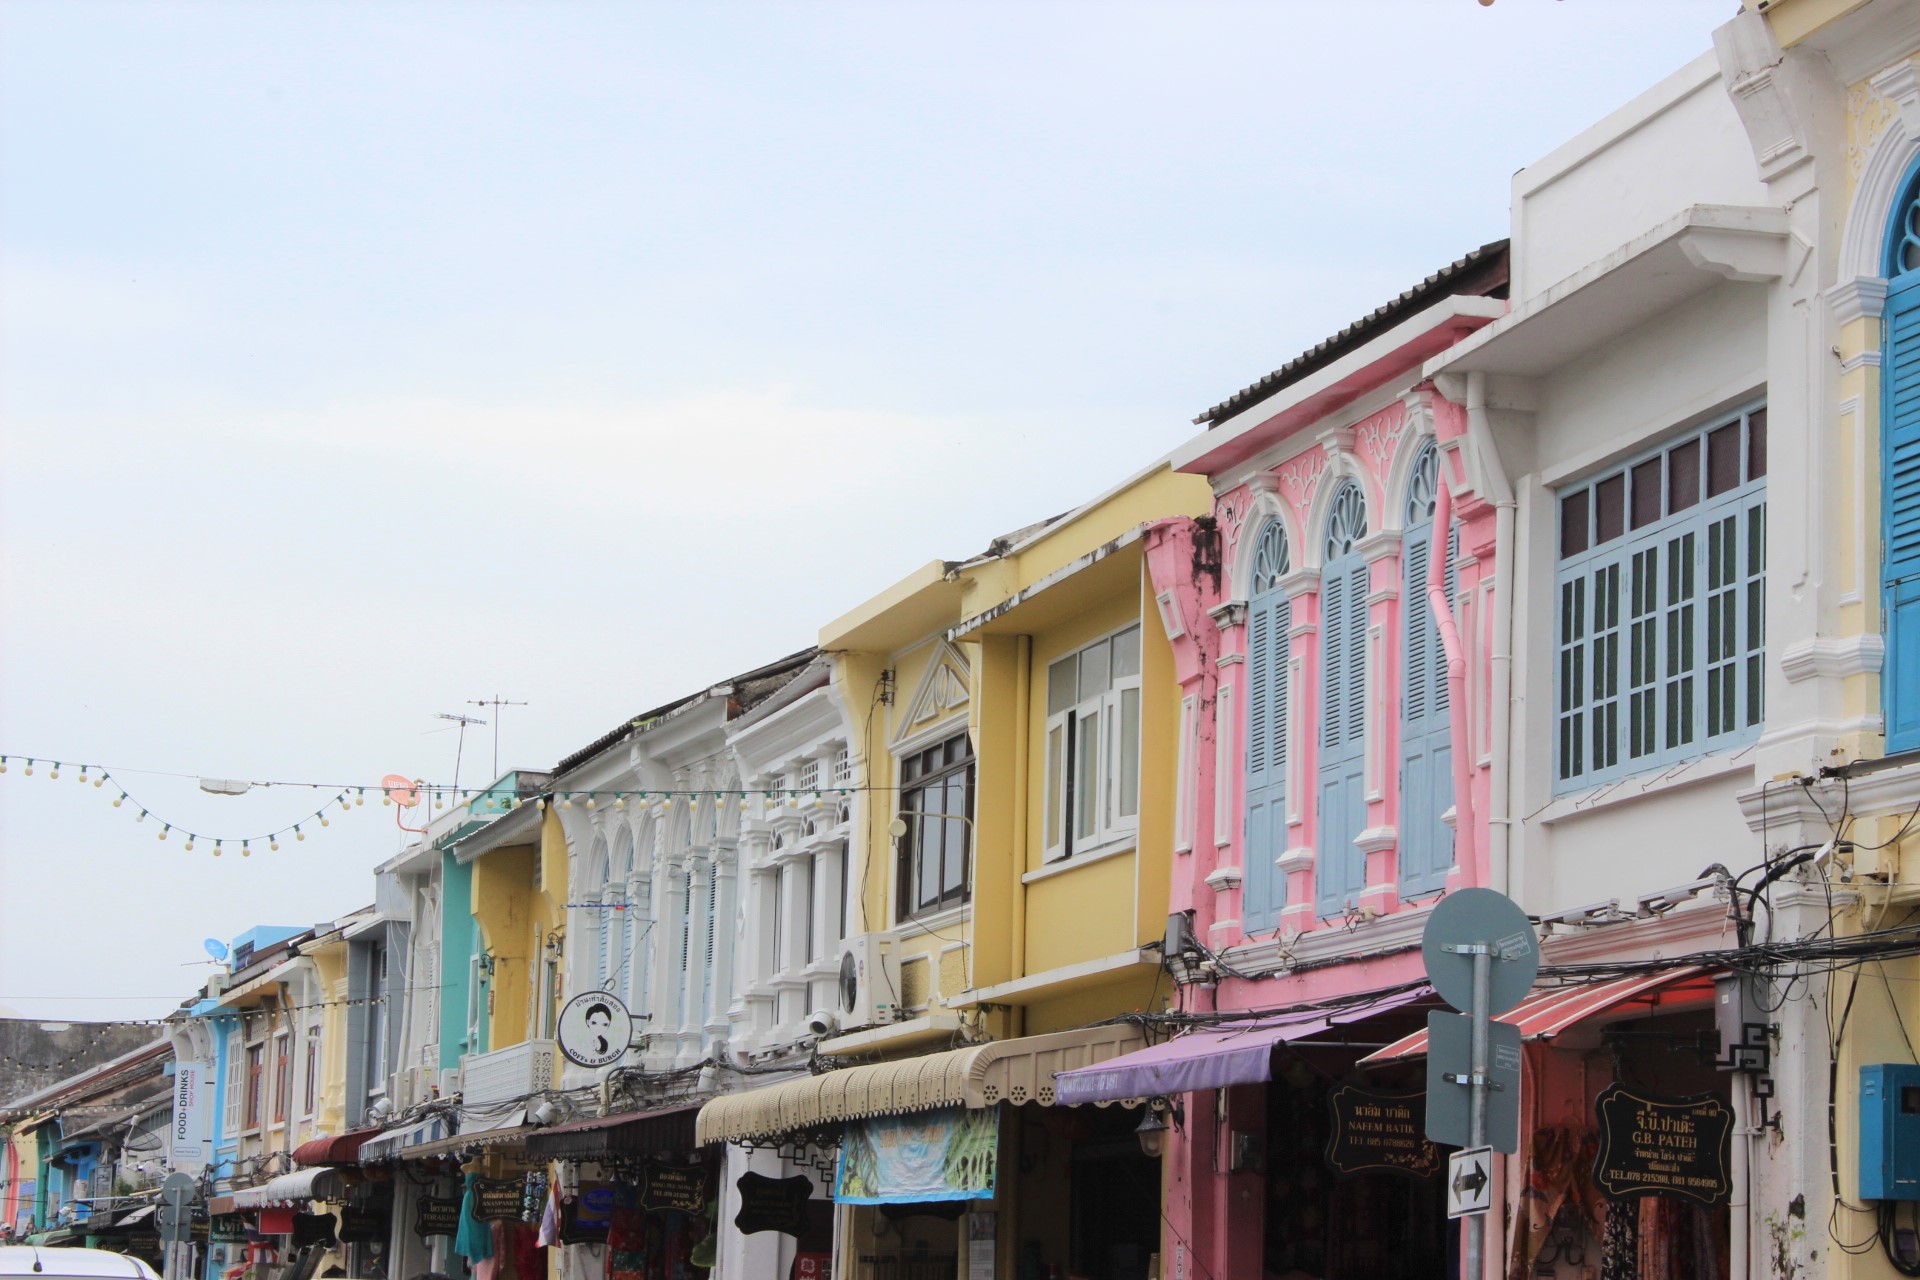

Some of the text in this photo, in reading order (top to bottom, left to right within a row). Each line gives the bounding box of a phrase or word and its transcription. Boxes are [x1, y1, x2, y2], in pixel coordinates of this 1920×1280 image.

[598, 1048, 622, 1064] BURGH
[178, 1069, 189, 1140] FOOD+DRINKS
[1348, 1120, 1415, 1134] NAEEM BATIK
[1632, 1131, 1698, 1149] G.B. PATEH
